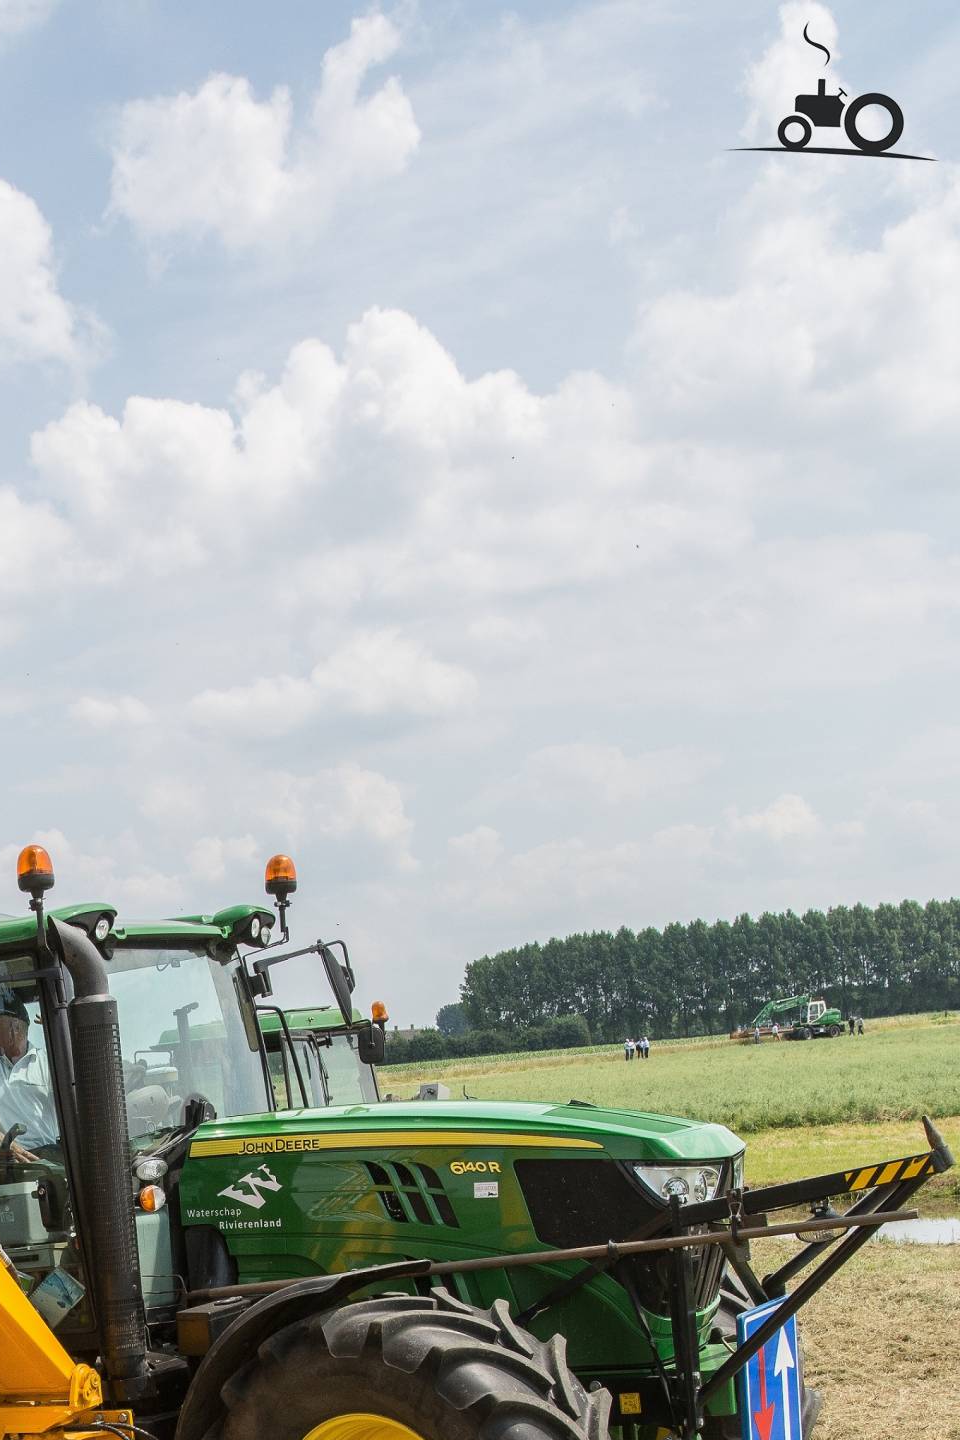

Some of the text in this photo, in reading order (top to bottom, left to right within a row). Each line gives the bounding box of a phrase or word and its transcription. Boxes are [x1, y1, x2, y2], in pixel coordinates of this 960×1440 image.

[240, 1138, 319, 1153] JOHN DEERE
[187, 1207, 242, 1218] Waterschap
[219, 1218, 282, 1230] Rivierenland
